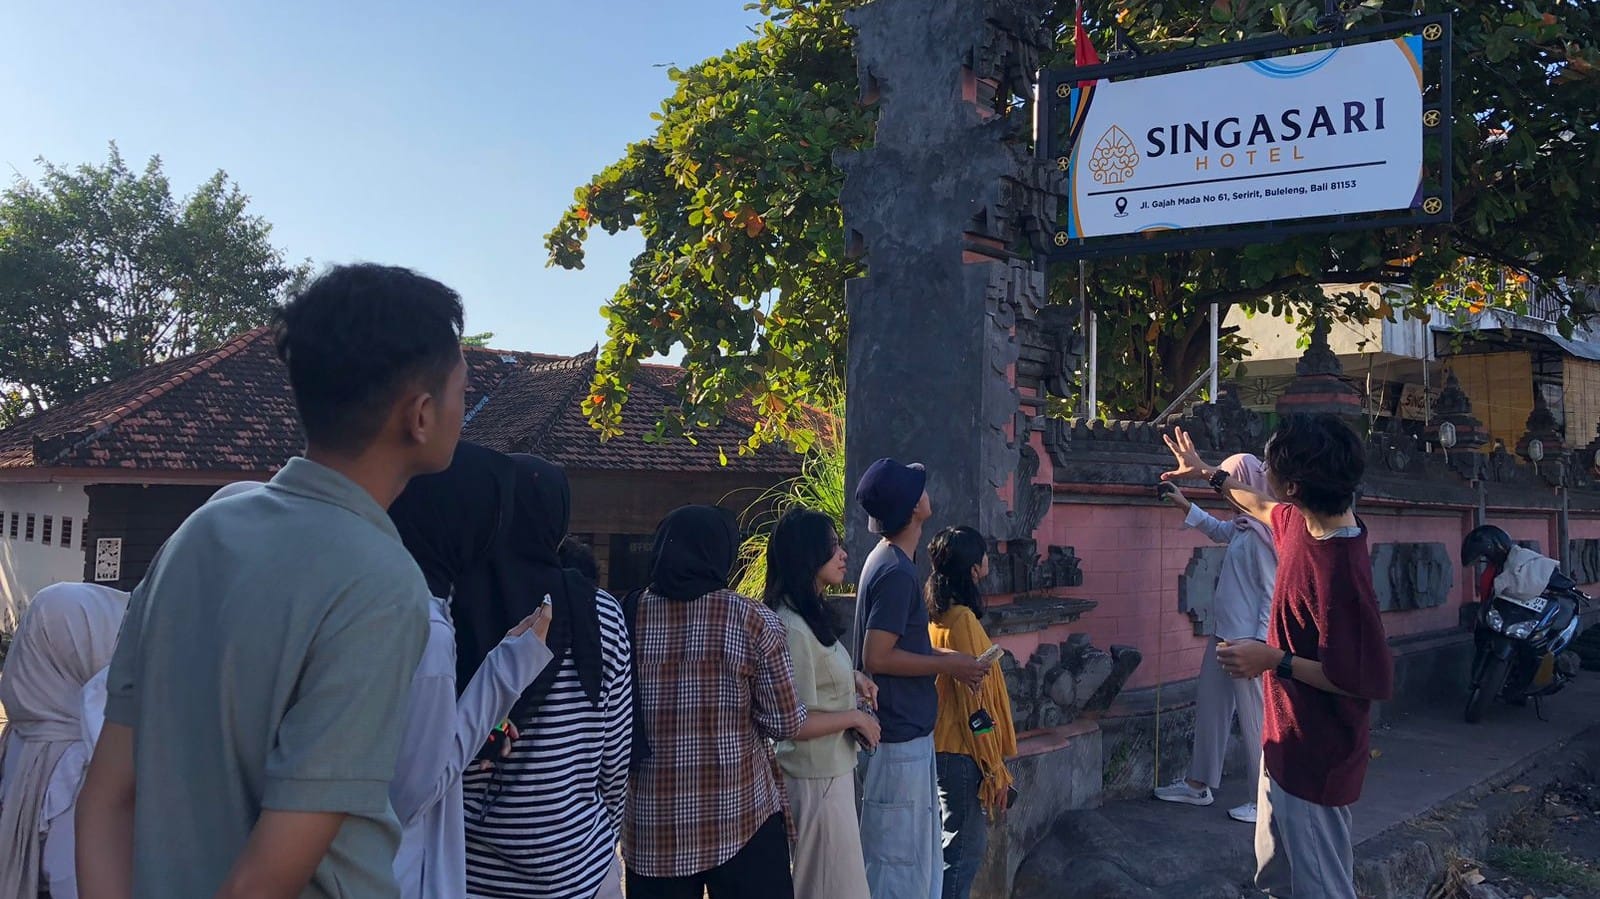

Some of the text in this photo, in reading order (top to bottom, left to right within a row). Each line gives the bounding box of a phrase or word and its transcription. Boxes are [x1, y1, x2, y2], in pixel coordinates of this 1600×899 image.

[1146, 96, 1386, 158] SINGASARI
[1196, 145, 1305, 170] HOTEL
[1139, 179, 1357, 210] Jl. Gajah Mada No 61, Seririt, Buleleng, Bali 81153
